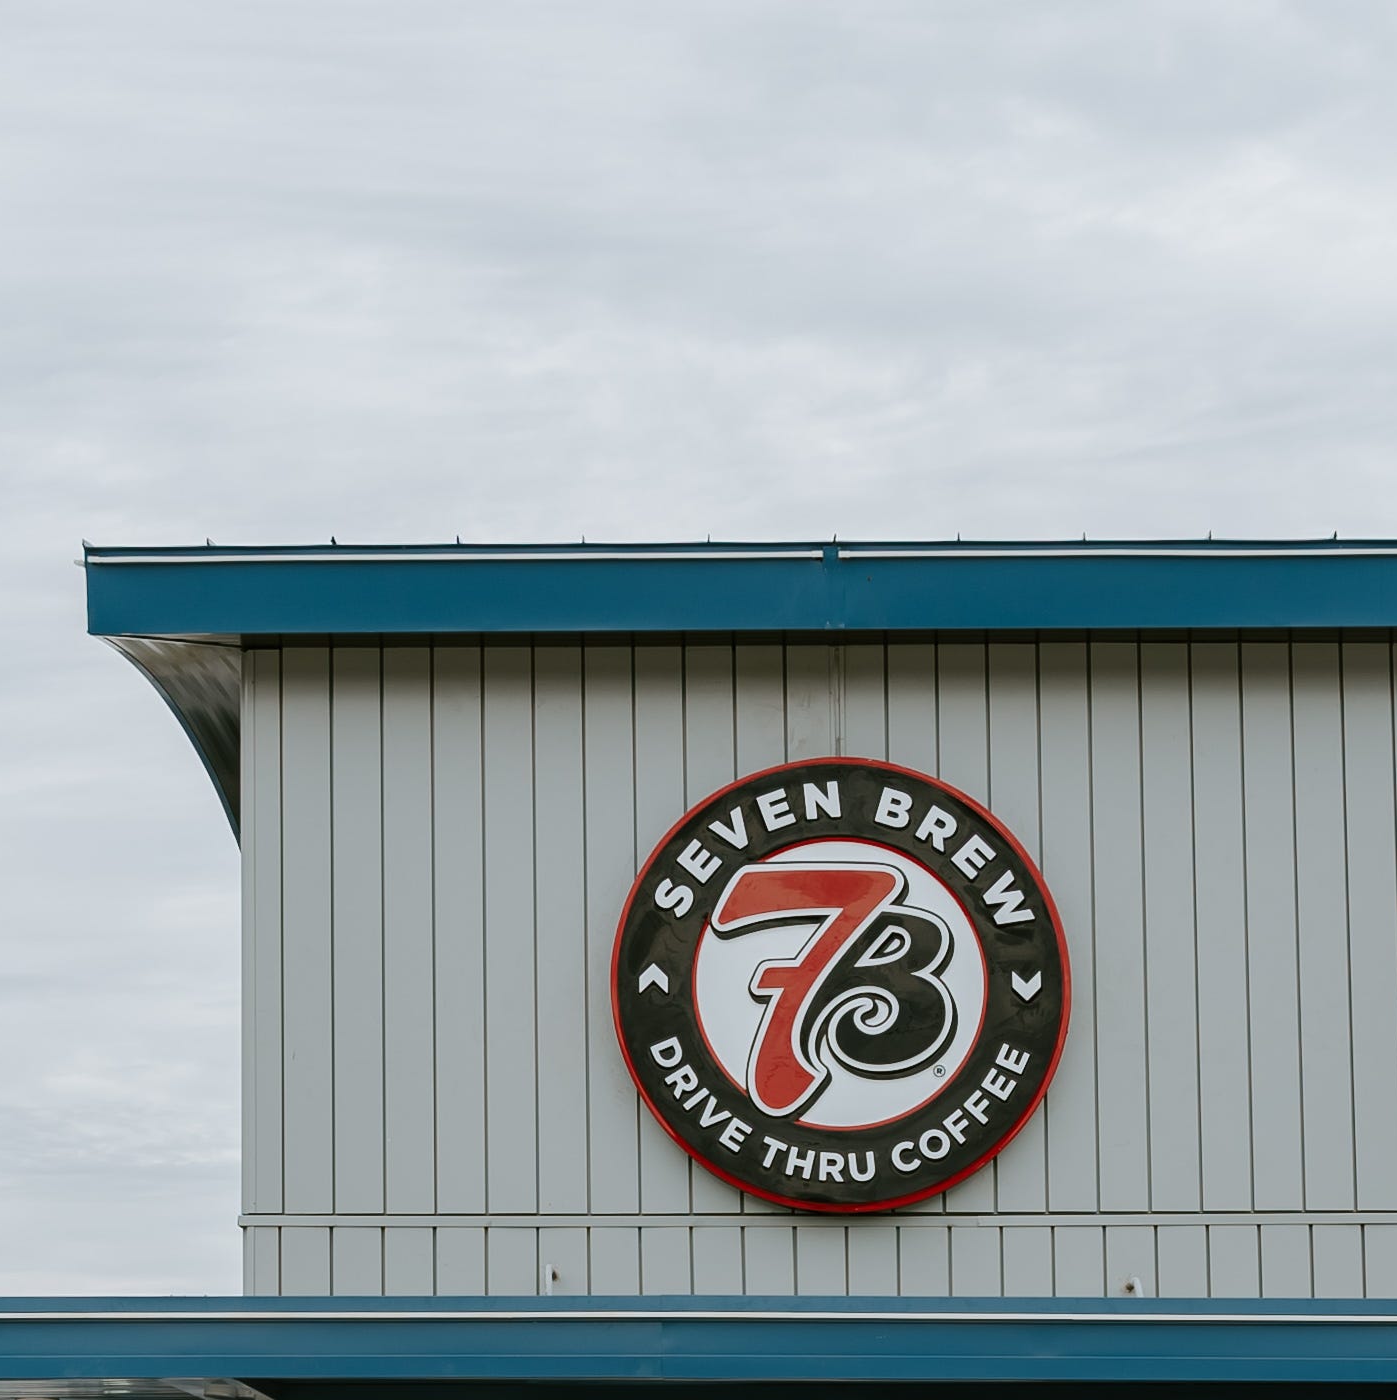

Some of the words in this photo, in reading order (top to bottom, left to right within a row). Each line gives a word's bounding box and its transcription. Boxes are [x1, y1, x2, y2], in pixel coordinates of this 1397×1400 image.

[653, 780, 842, 919] SEVEN
[873, 786, 1035, 926] BREW
[649, 1035, 754, 1155] DRIVE
[761, 1135, 876, 1183] THRU
[890, 1041, 1032, 1172] COFFEE
